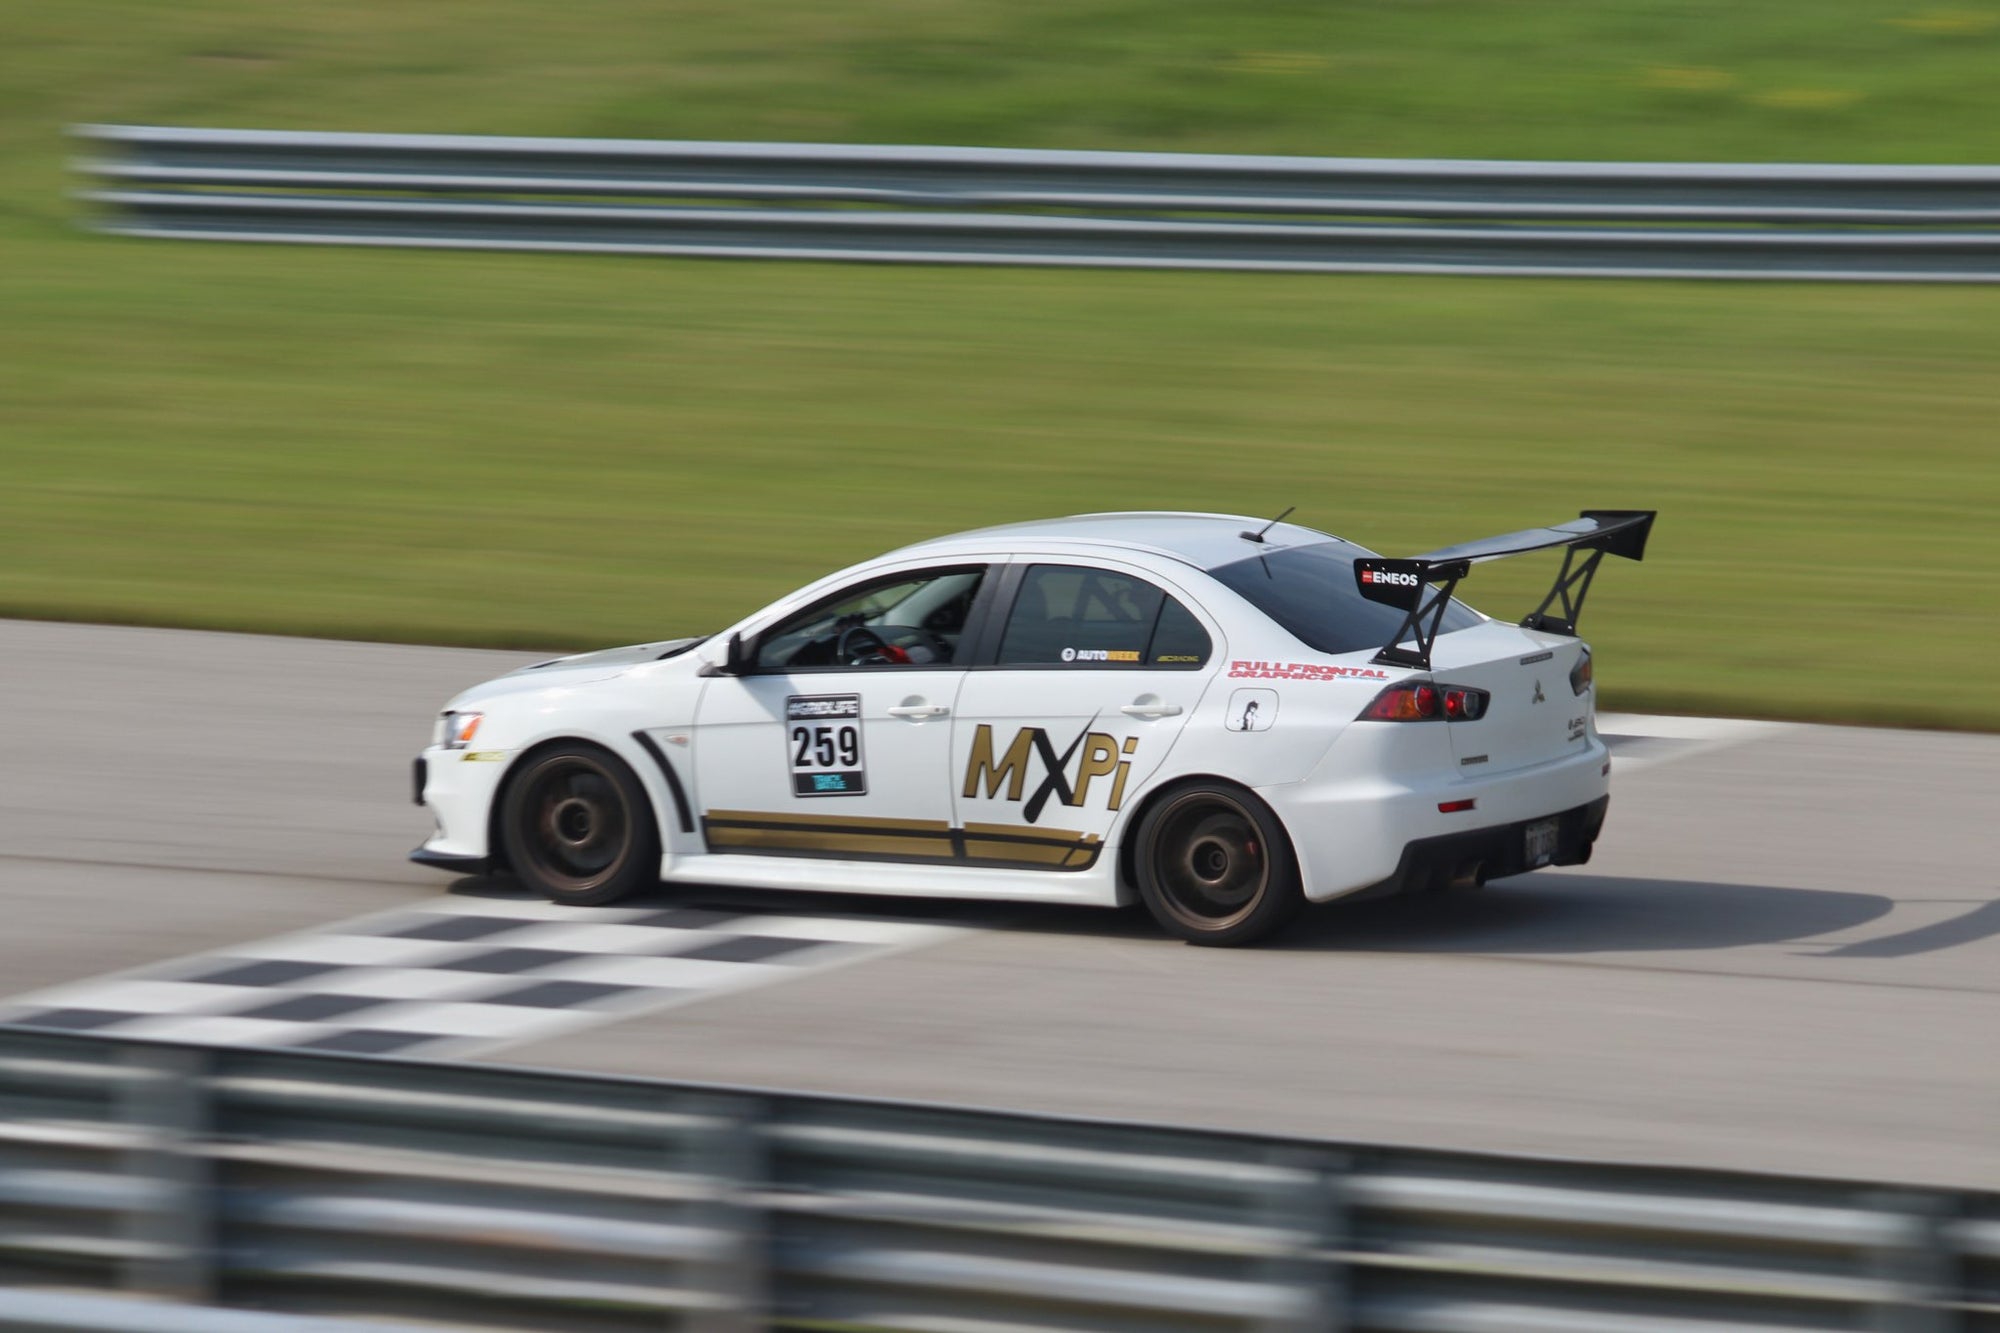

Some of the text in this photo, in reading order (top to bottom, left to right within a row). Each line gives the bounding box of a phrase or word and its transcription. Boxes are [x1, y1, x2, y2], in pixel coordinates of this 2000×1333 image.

[1373, 571, 1418, 586] ENEOS
[1227, 671, 1335, 681] GRAPHICS
[1230, 661, 1389, 679] FULLFRONTAL
[793, 726, 858, 767] 259
